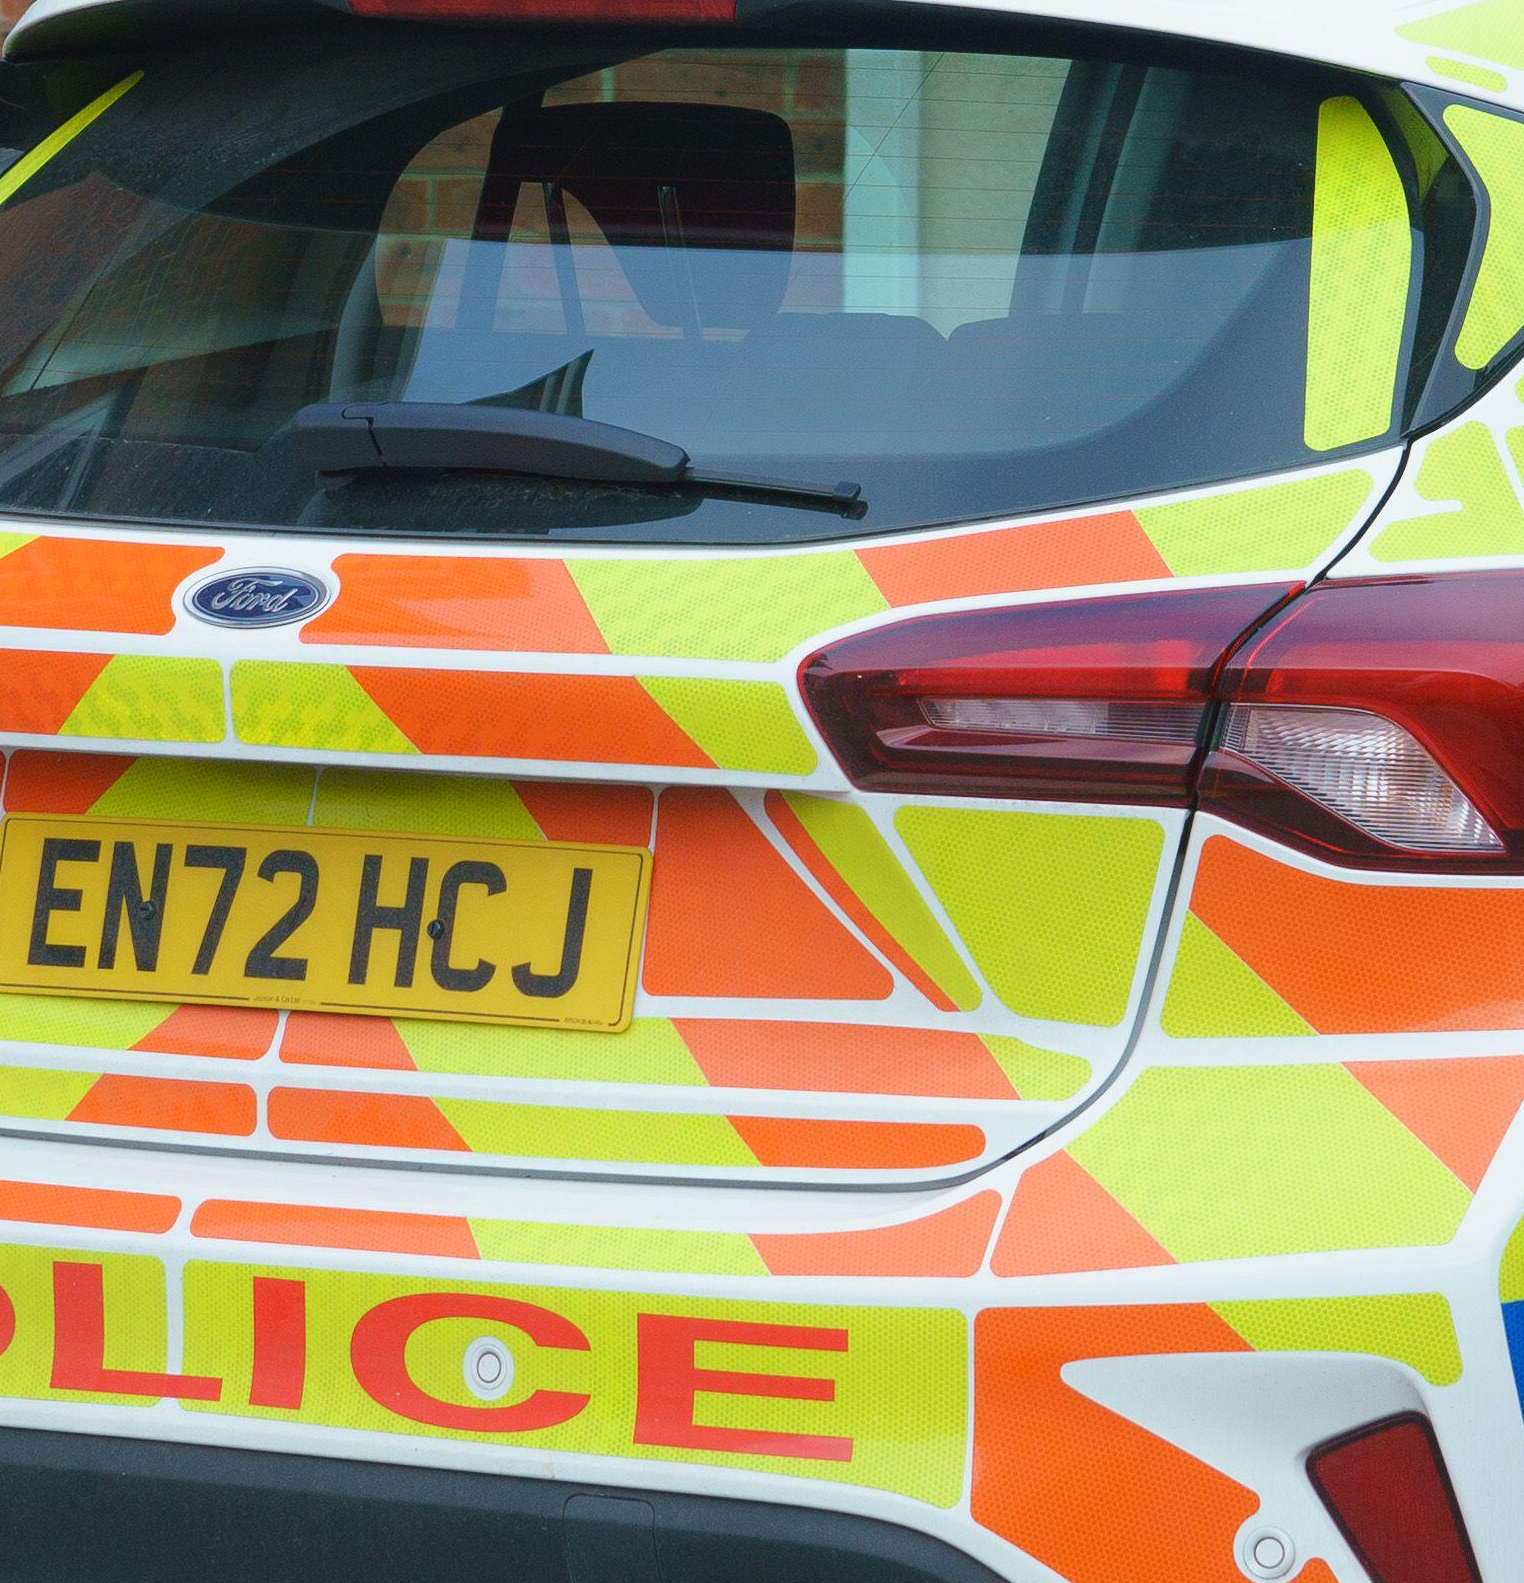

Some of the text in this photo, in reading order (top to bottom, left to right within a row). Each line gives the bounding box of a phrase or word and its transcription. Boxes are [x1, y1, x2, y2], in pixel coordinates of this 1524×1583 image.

[210, 577, 299, 613] Ford
[27, 837, 596, 999] EN72 HCJ
